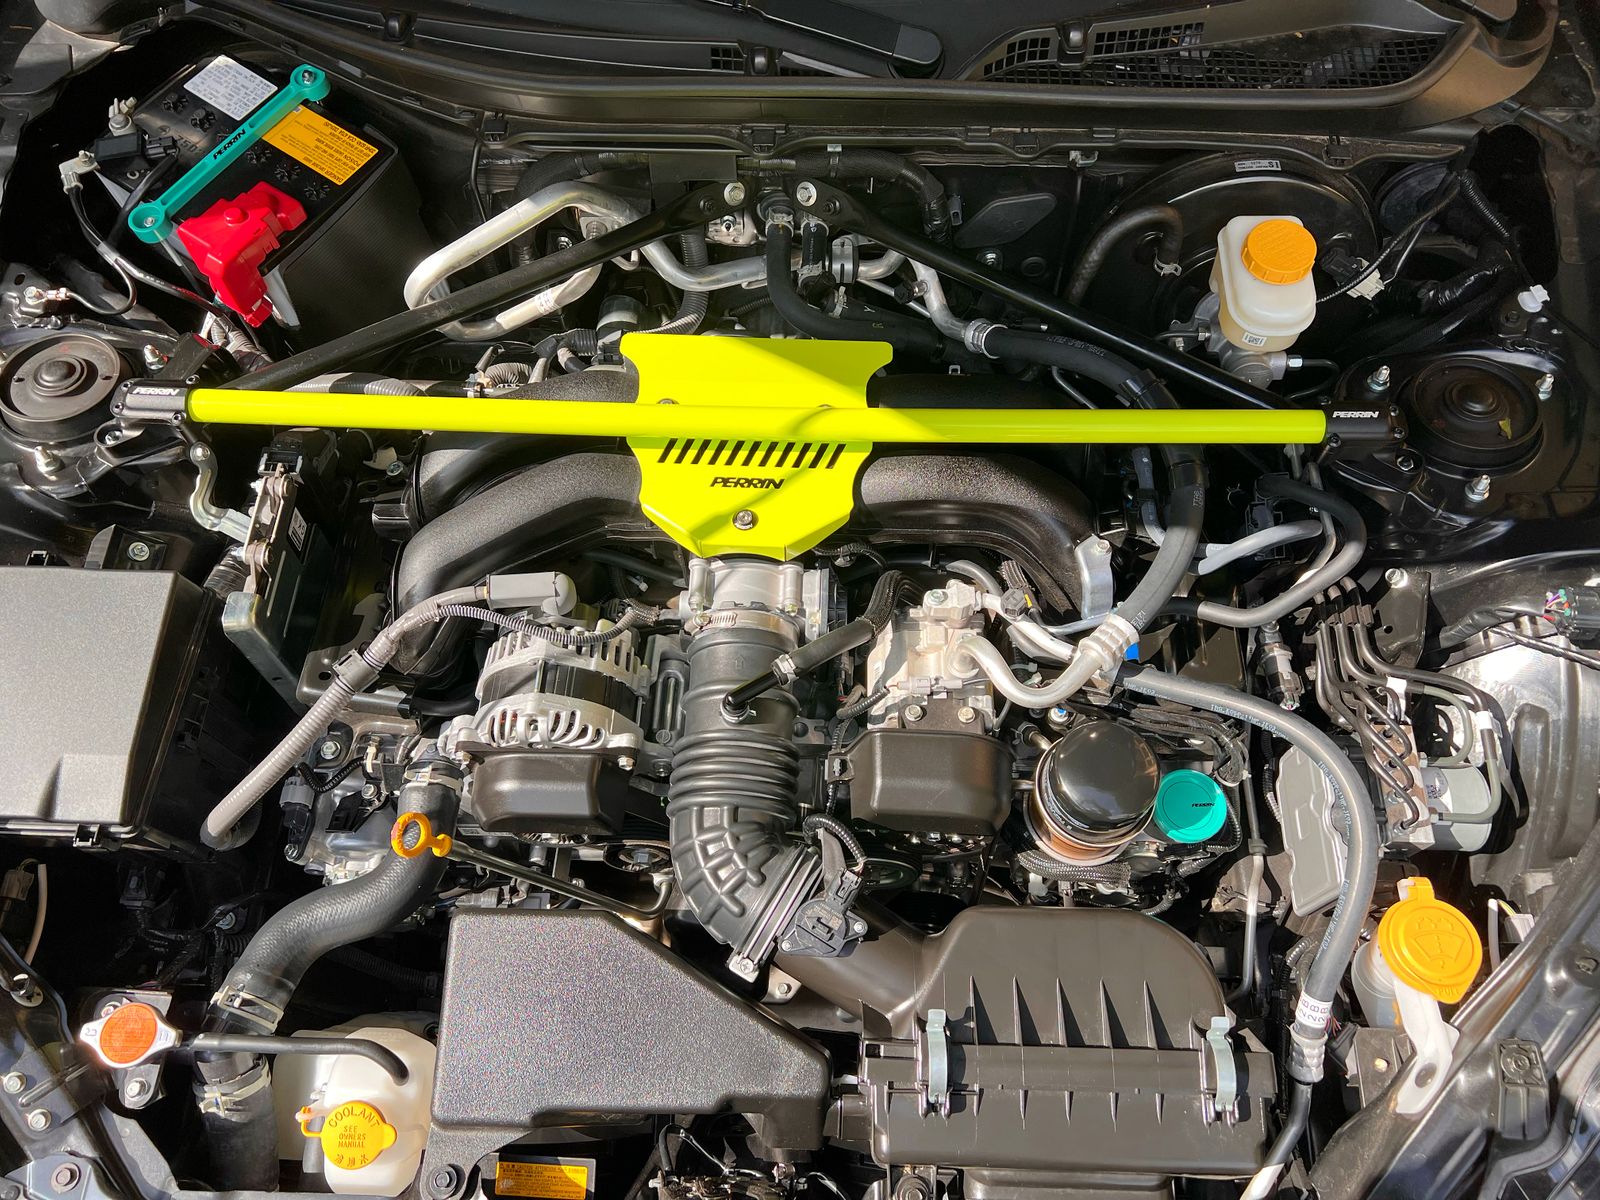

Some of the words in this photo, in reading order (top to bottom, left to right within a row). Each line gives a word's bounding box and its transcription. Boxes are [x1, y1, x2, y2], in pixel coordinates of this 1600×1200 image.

[213, 128, 246, 160] PERRIN
[132, 387, 180, 396] PERRIN
[1332, 410, 1379, 418] PERRIN
[709, 477, 784, 490] PERRIN
[328, 1106, 380, 1128] COOLANT
[343, 1125, 358, 1133] SEE
